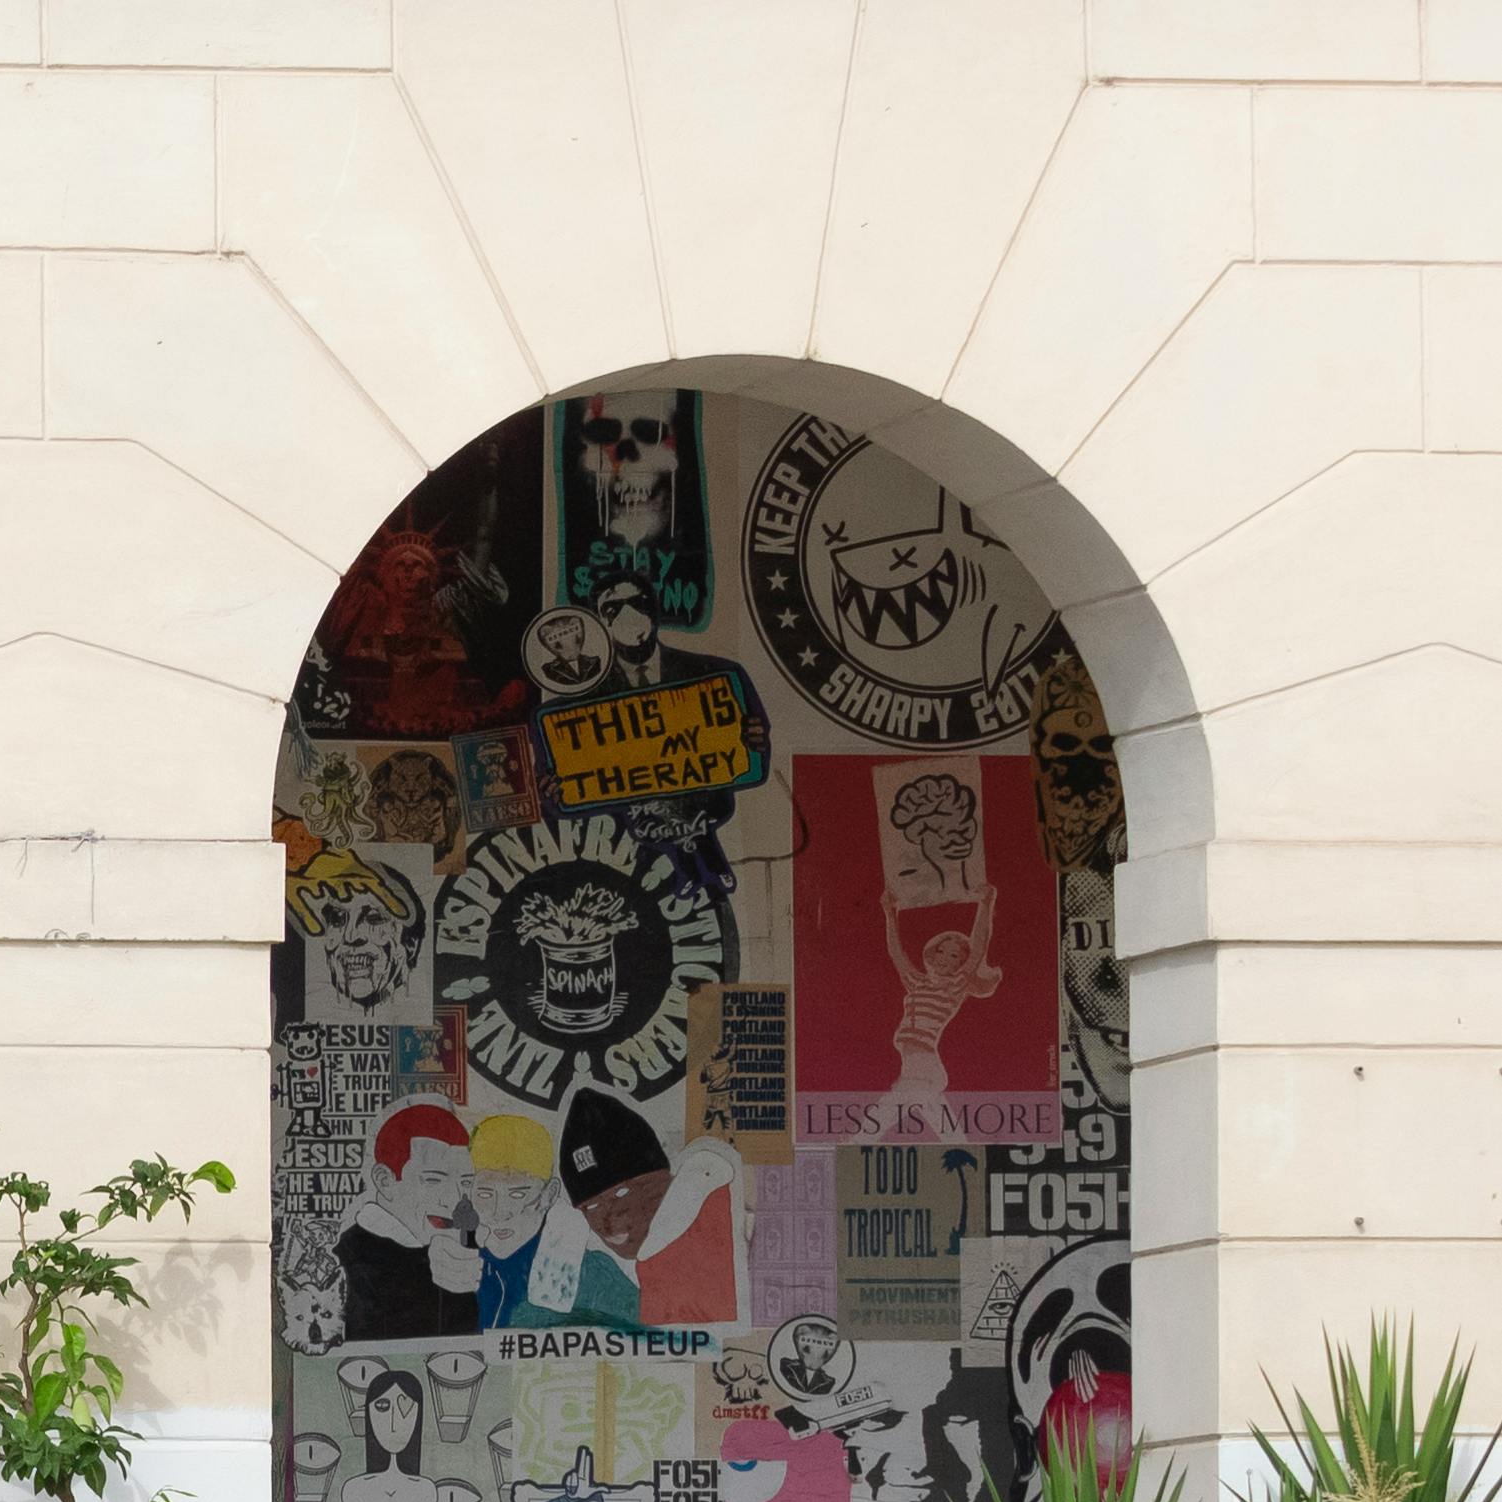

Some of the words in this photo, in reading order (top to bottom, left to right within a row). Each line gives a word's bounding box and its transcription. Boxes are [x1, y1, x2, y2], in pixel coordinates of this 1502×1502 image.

[754, 463, 811, 556] KEEP
[589, 541, 676, 577] STAY
[819, 665, 954, 740] SHARPY
[970, 665, 1039, 734] 2017
[555, 699, 666, 751] THIS
[700, 685, 737, 728] IS
[661, 725, 701, 757] MY
[563, 747, 738, 799] THERAPY
[547, 965, 615, 995] SPINACH
[723, 991, 786, 1006] PORTLAND
[325, 1025, 390, 1048] ESUS
[723, 1020, 786, 1034] PORTLAND
[351, 1052, 391, 1073] WAY
[343, 1074, 391, 1091] TRUTH
[805, 1103, 882, 1136] LESS
[896, 1103, 925, 1136] IS
[939, 1103, 1054, 1136] MORE
[289, 1173, 314, 1194] HE
[320, 1173, 364, 1194] WAY
[860, 1146, 918, 1195] TODO
[287, 1194, 309, 1212] HE
[843, 1208, 938, 1259] TROPICAL
[859, 1285, 961, 1305] MOVIMIENT
[499, 1330, 710, 1359] #BAPASTEUP
